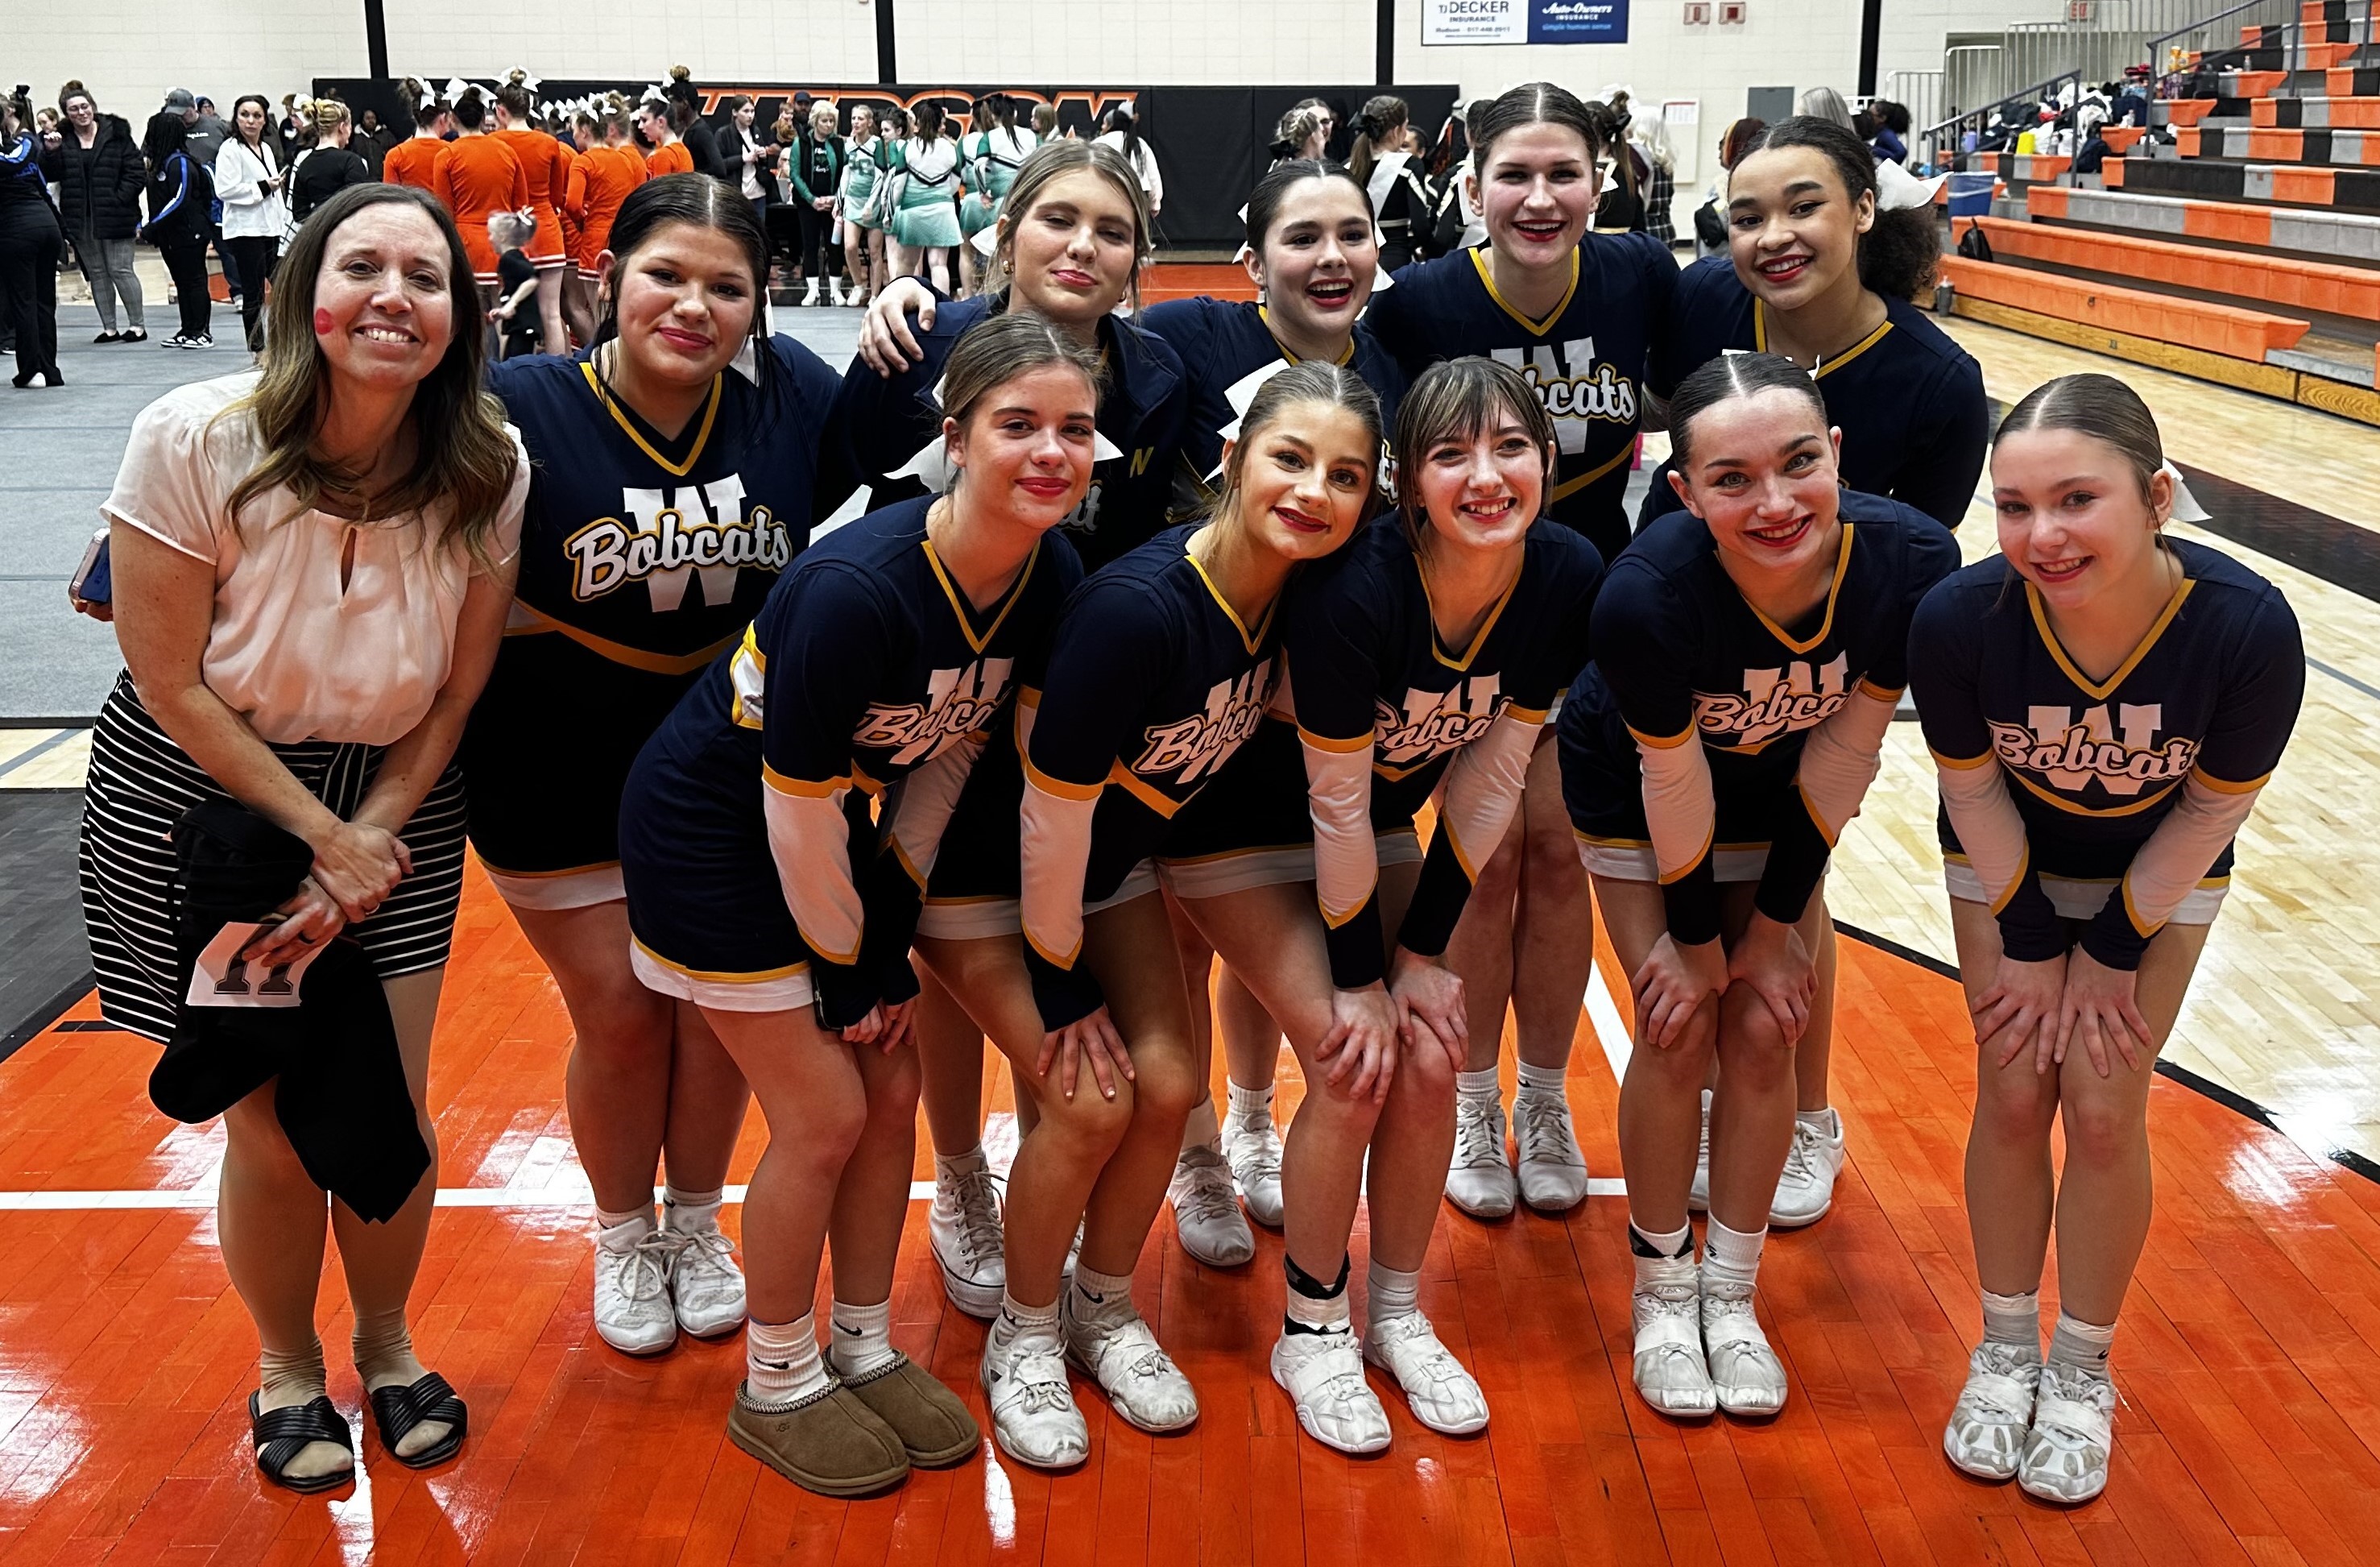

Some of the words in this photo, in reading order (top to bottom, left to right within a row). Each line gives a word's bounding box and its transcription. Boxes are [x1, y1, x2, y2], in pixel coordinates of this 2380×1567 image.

[1449, 1, 1509, 13] DECKER
[1542, 2, 1612, 14] Auto-Owners
[564, 506, 793, 602] Bobcats
[623, 473, 747, 612] W
[1691, 678, 1859, 734] Bobca
[1986, 717, 2203, 781] Bobcat
[2028, 703, 2162, 794] W
